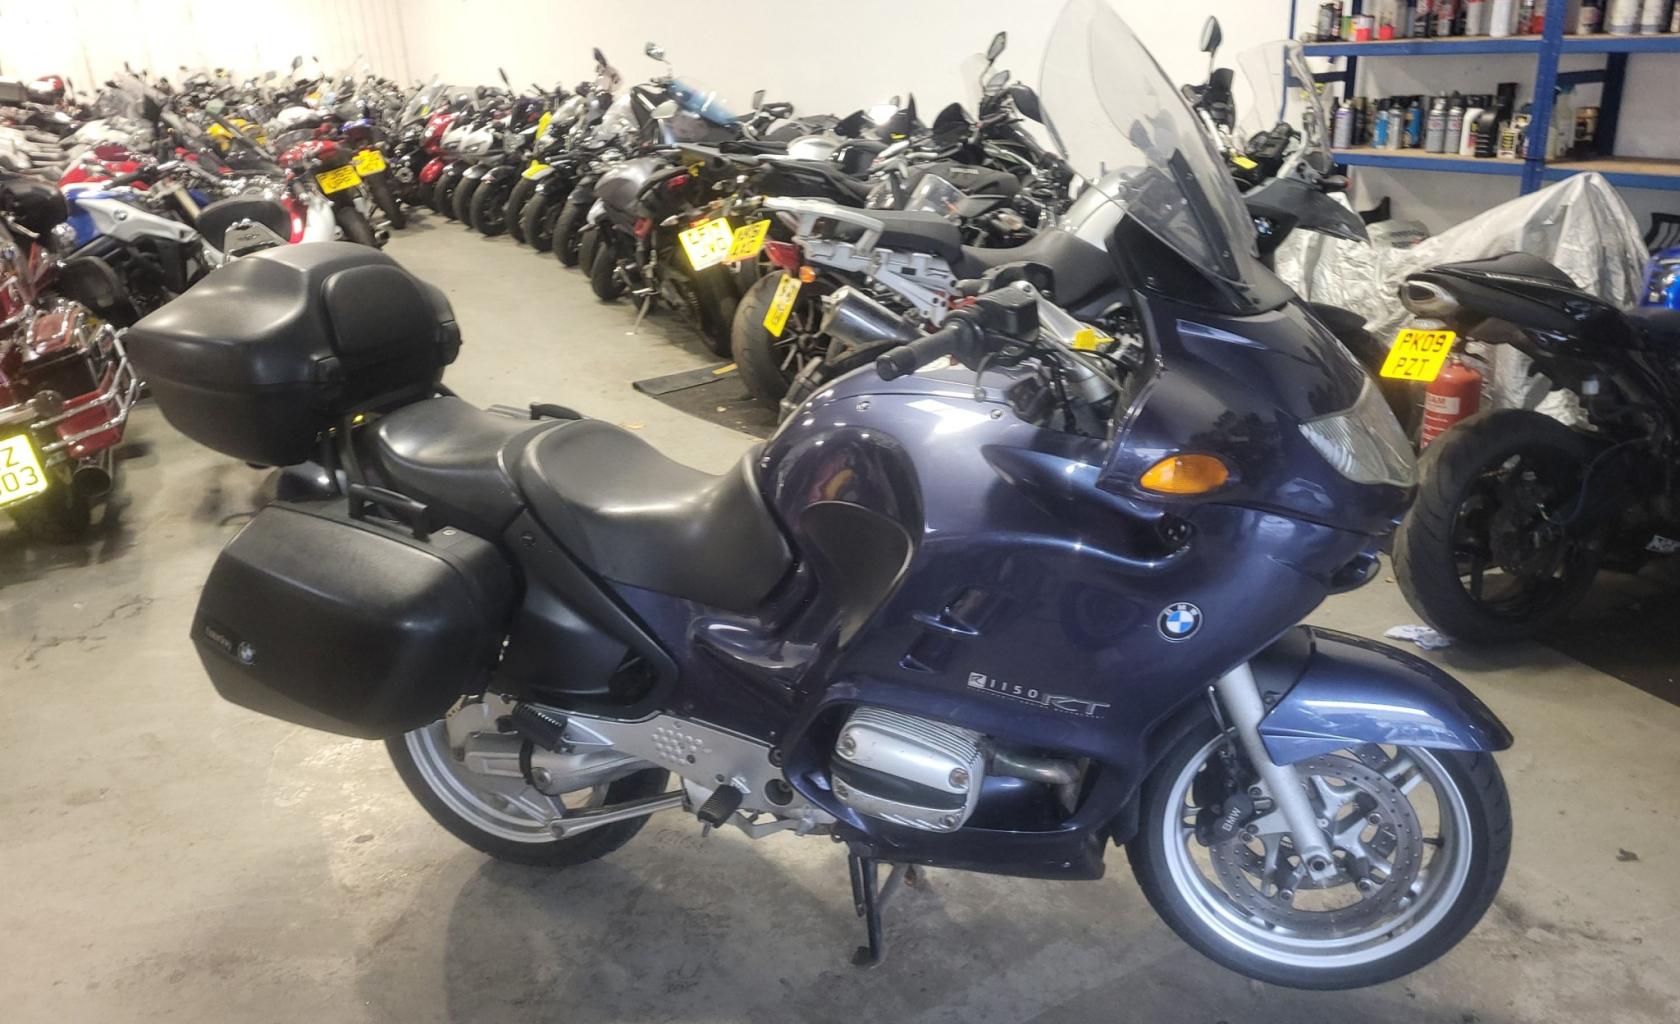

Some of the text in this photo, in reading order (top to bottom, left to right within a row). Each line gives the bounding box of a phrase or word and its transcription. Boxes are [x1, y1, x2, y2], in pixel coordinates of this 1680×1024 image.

[1399, 332, 1447, 353] PK09
[1392, 357, 1430, 376] PZT
[0, 466, 39, 496] 03
[990, 679, 1040, 699] 1150
[1222, 806, 1242, 832] BMW
